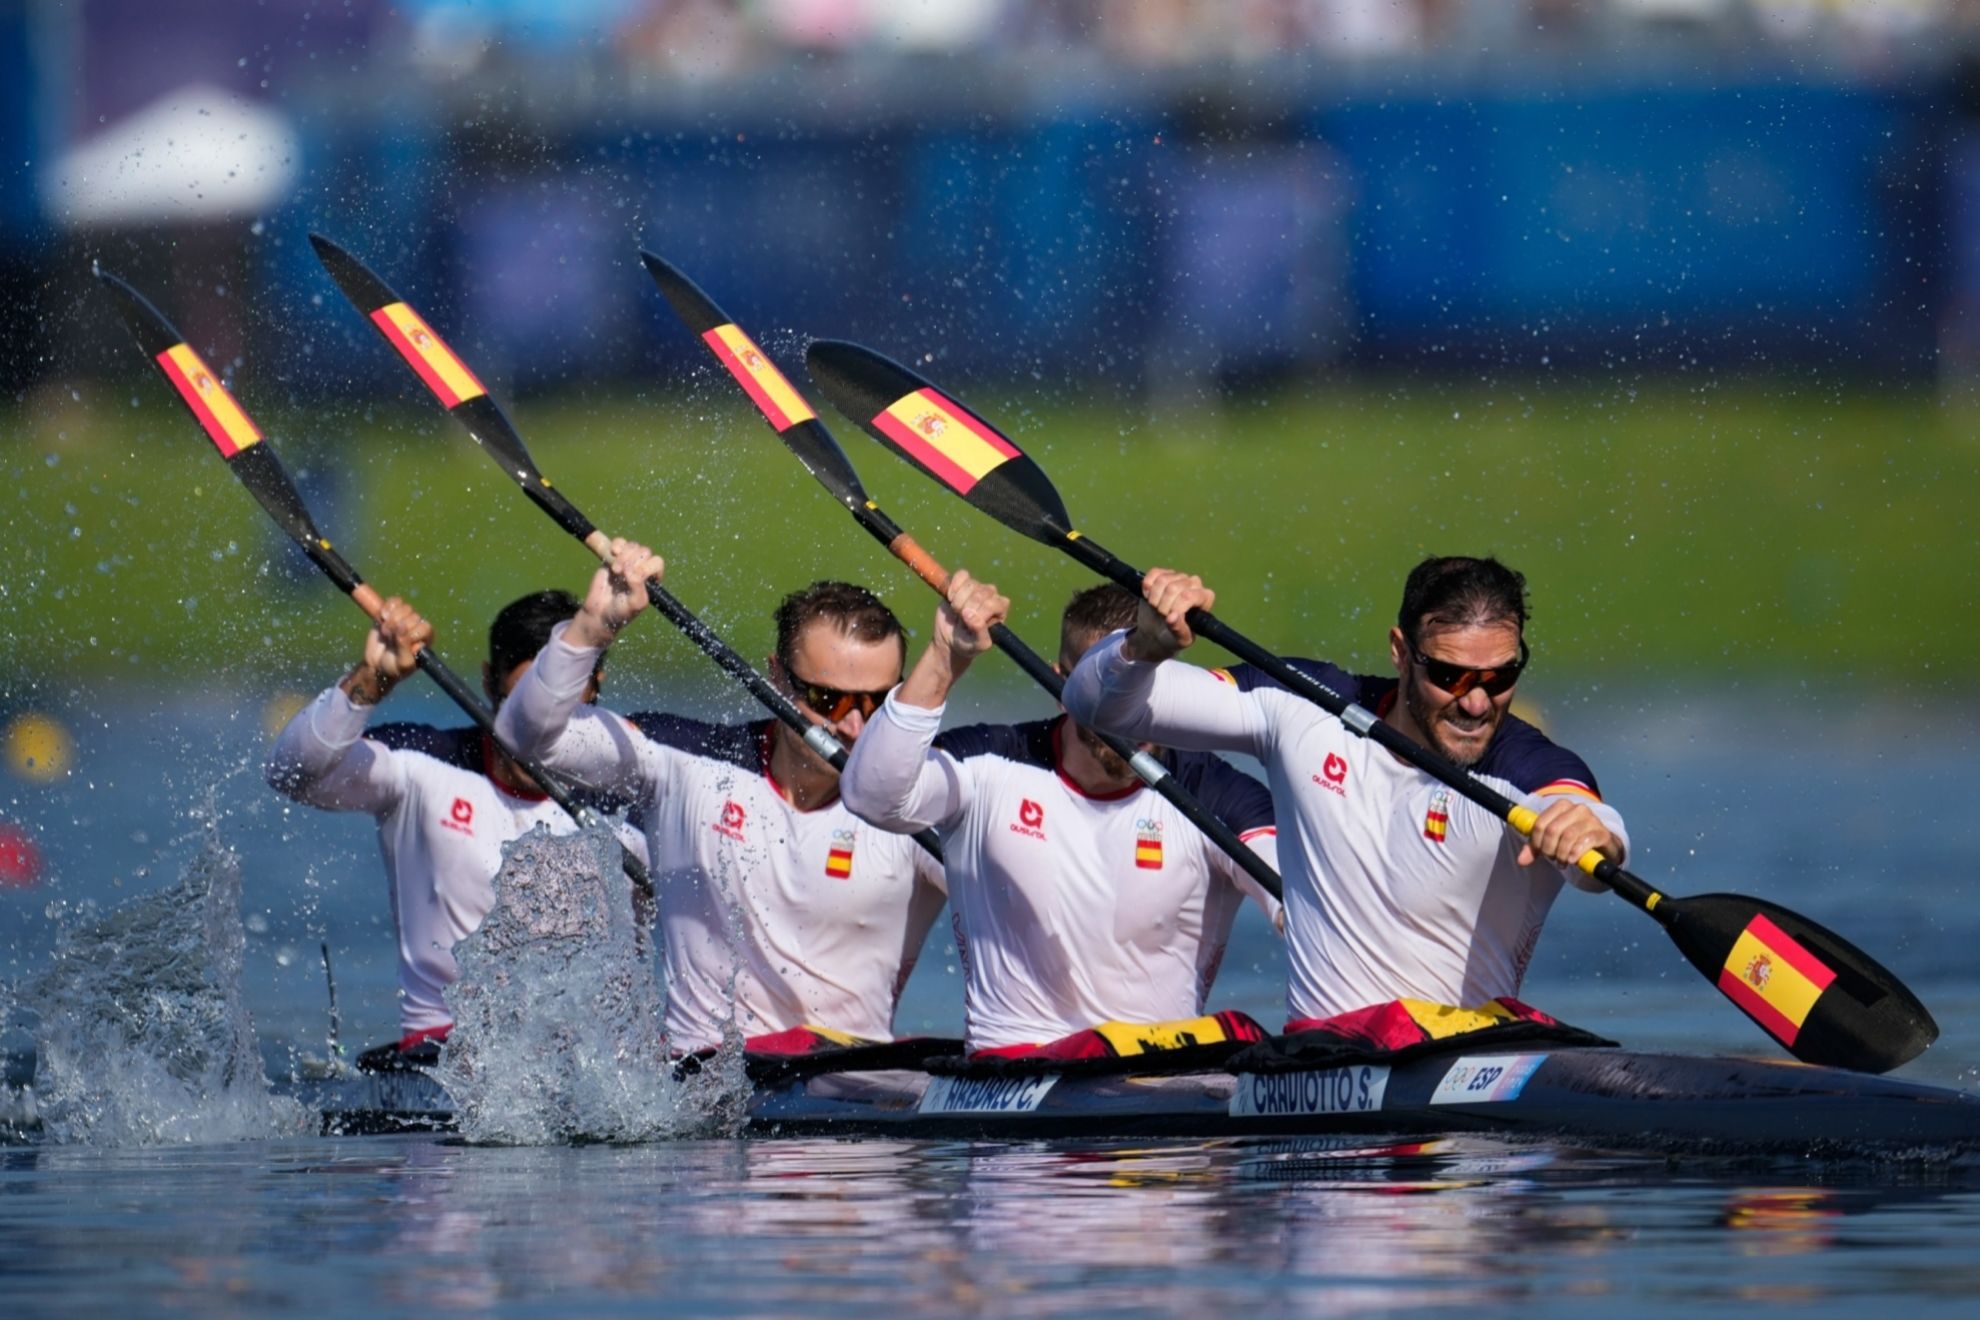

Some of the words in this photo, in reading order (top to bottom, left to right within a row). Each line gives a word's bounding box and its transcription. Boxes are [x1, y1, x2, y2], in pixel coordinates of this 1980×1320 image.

[1253, 1067, 1353, 1114] CRAVIOTTO
[1357, 1066, 1373, 1110] S.
[1467, 1066, 1503, 1091] ESP
